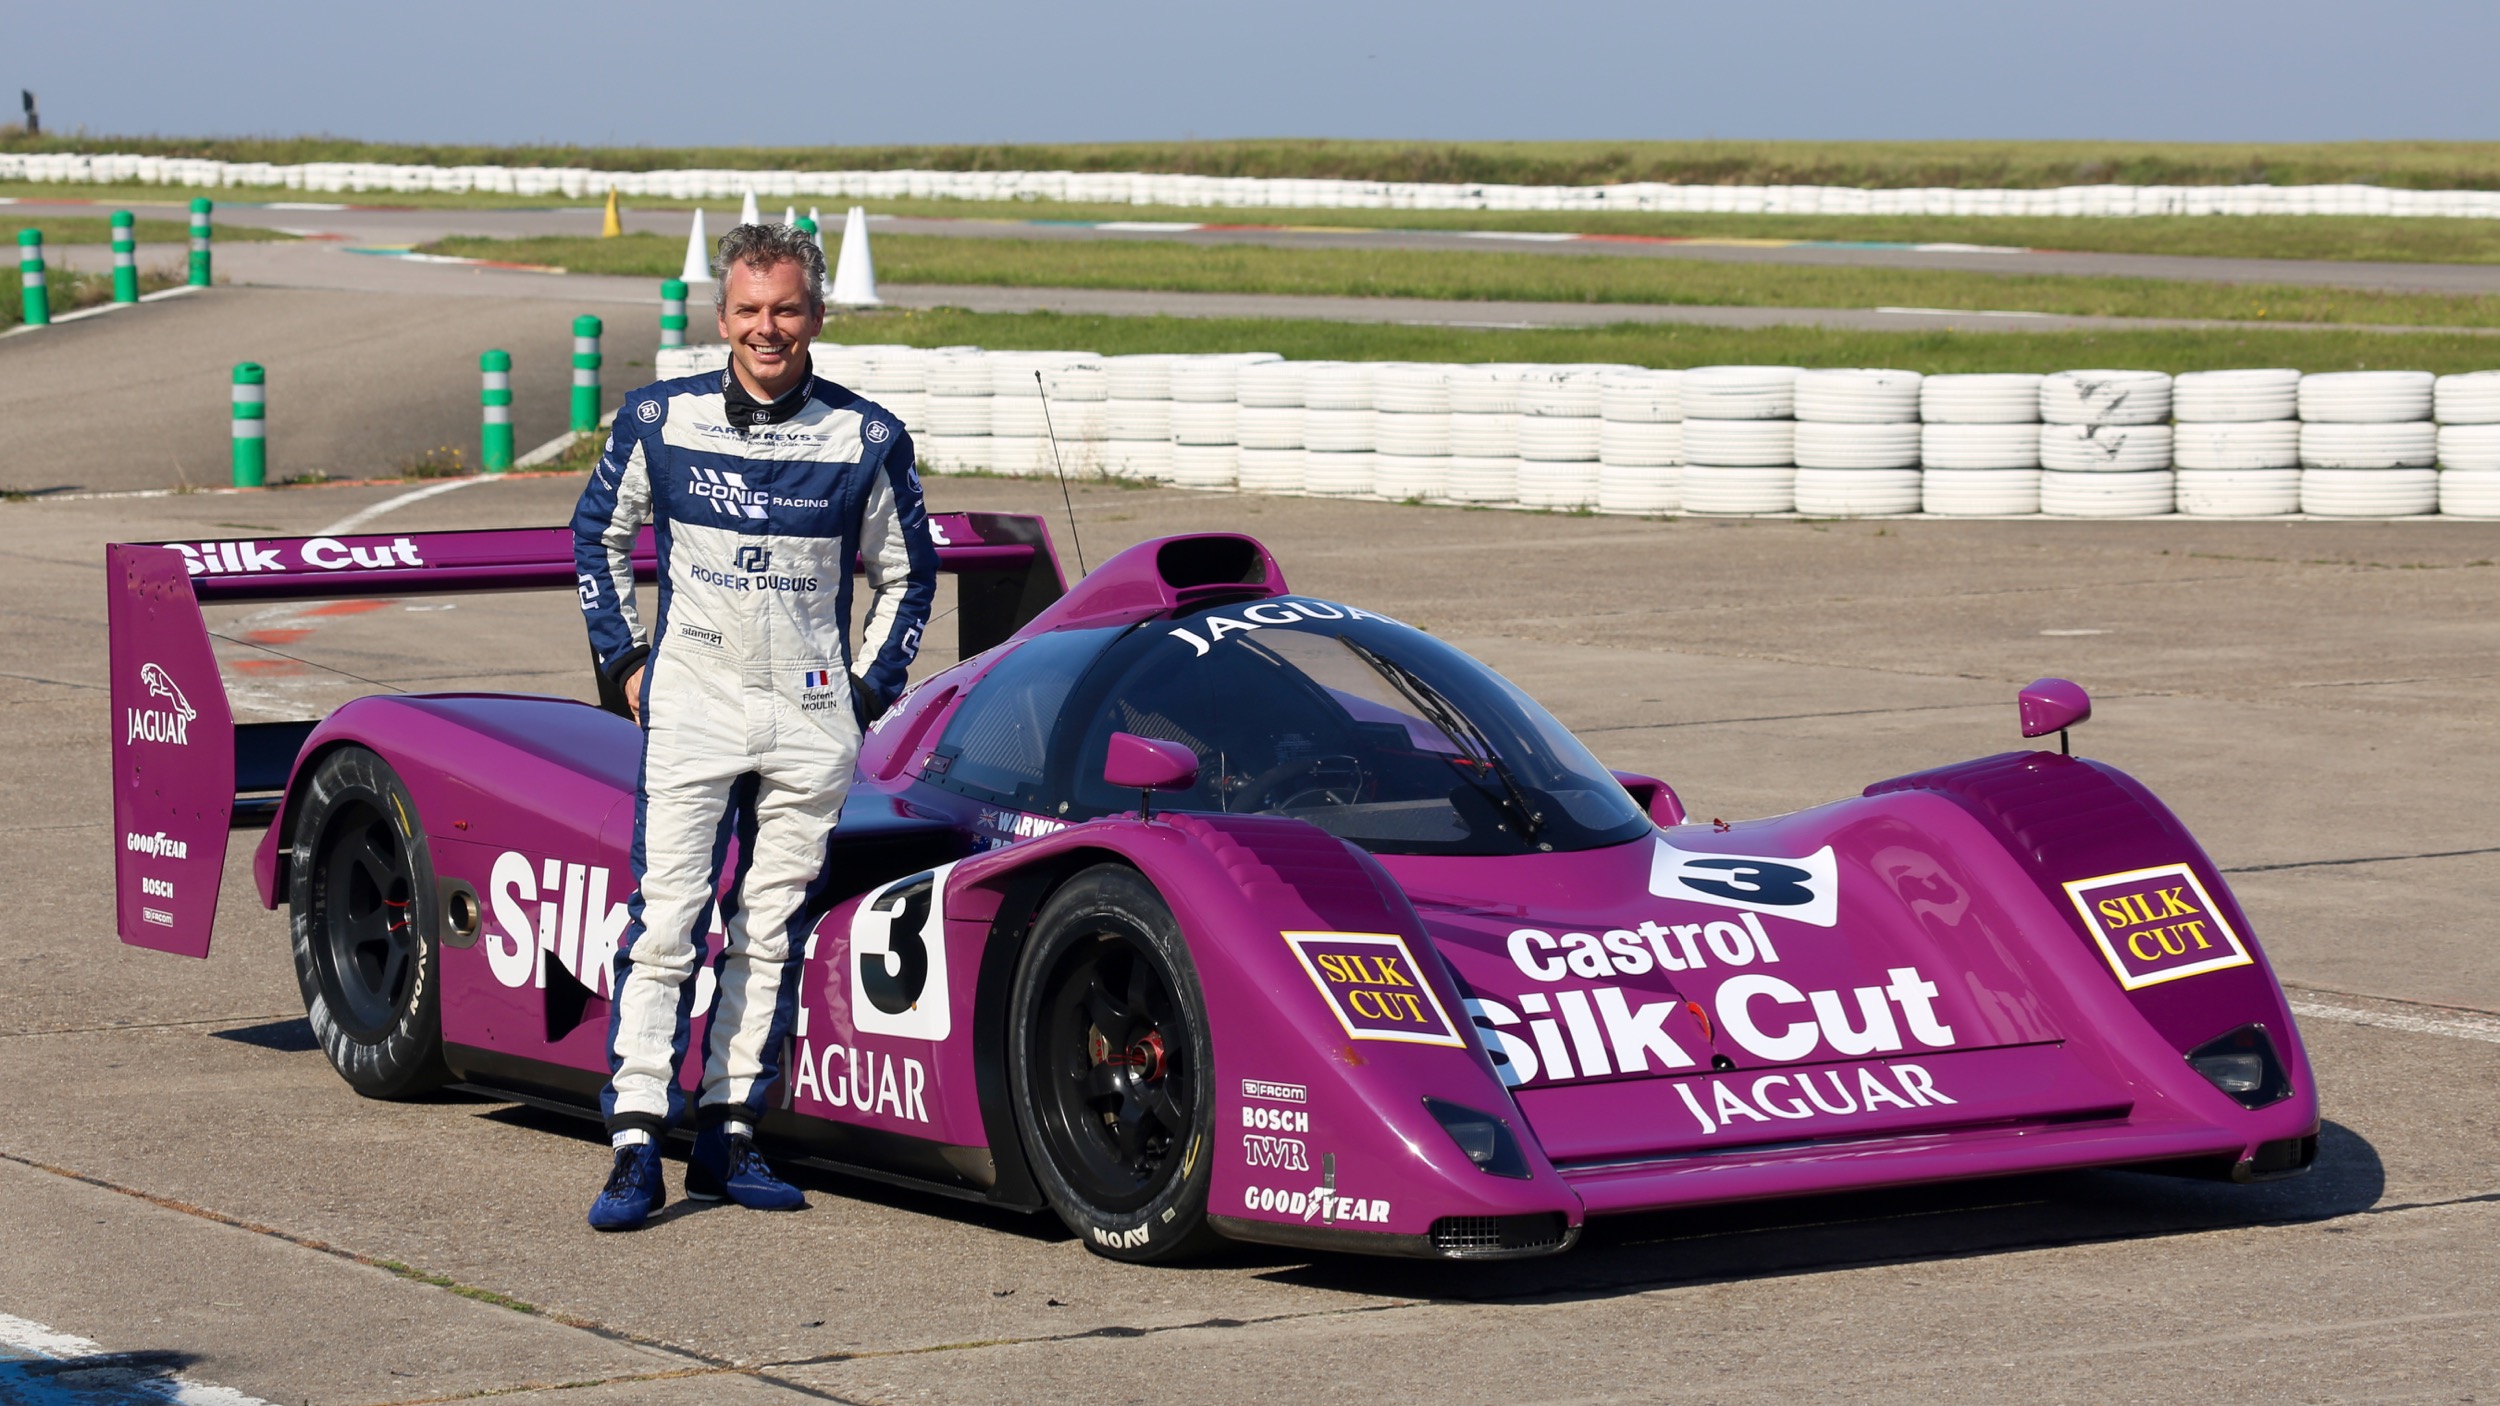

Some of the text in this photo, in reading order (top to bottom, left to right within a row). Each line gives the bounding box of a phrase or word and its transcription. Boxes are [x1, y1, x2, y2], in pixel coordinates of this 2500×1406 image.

[764, 433, 811, 441] REVS
[688, 480, 829, 508] ICONIC RACING
[301, 537, 424, 569] Cut
[690, 564, 818, 592] ROGER DUBUIS
[1168, 602, 1411, 657] JAGUA
[801, 700, 837, 711] MOULIN
[803, 691, 834, 701] Florent
[127, 708, 188, 746] JAGUAR
[127, 831, 187, 859] GOODYEAR
[142, 877, 174, 899] BOSCH
[1678, 858, 1815, 906] 3
[485, 851, 632, 1001] Silk
[2098, 886, 2200, 930] SILK
[860, 870, 936, 1015] 3
[1506, 911, 1780, 983] Castrol
[2127, 919, 2213, 962] CUT
[410, 935, 428, 1016] AVON
[1317, 953, 1414, 988] SILK
[1349, 990, 1428, 1024] CUT
[1714, 966, 1957, 1062] Cut
[1460, 986, 1696, 1087] Silk
[1673, 1063, 1958, 1135] JAGUAR
[1242, 1106, 1309, 1133] BOSCH
[1243, 1134, 1310, 1171] TWR
[1244, 1186, 1391, 1223] GOODYEAR
[1093, 1222, 1150, 1249] AVON
